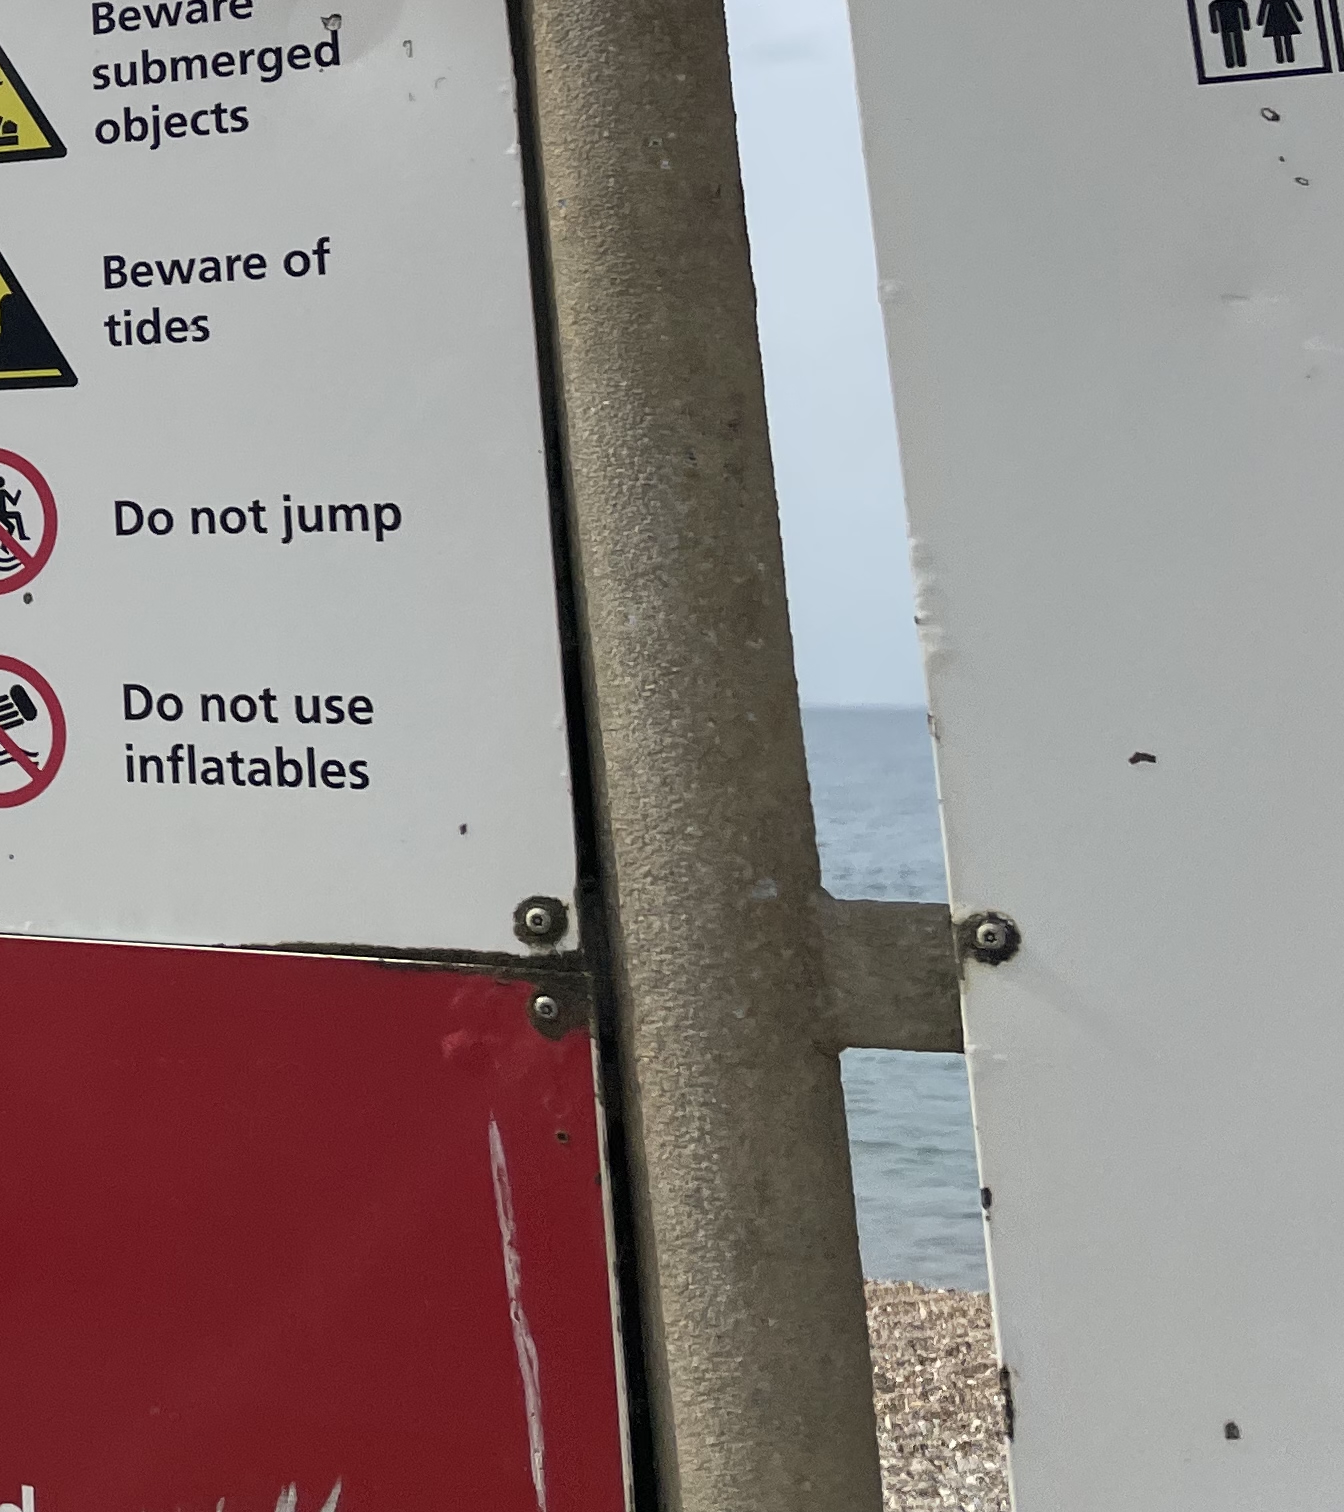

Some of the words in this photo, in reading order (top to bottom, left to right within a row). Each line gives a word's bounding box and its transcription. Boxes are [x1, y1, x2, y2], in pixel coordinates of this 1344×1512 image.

[91, 28, 342, 90] submerged
[96, 103, 248, 150] objects
[104, 254, 267, 289] Beware
[284, 237, 330, 277] of
[104, 307, 209, 346] tides
[115, 501, 173, 535] Do
[191, 500, 268, 534] not
[282, 495, 401, 544] jump
[123, 684, 183, 721] Do
[201, 688, 278, 723] not
[295, 696, 373, 724] use
[126, 744, 369, 789] inflatables
